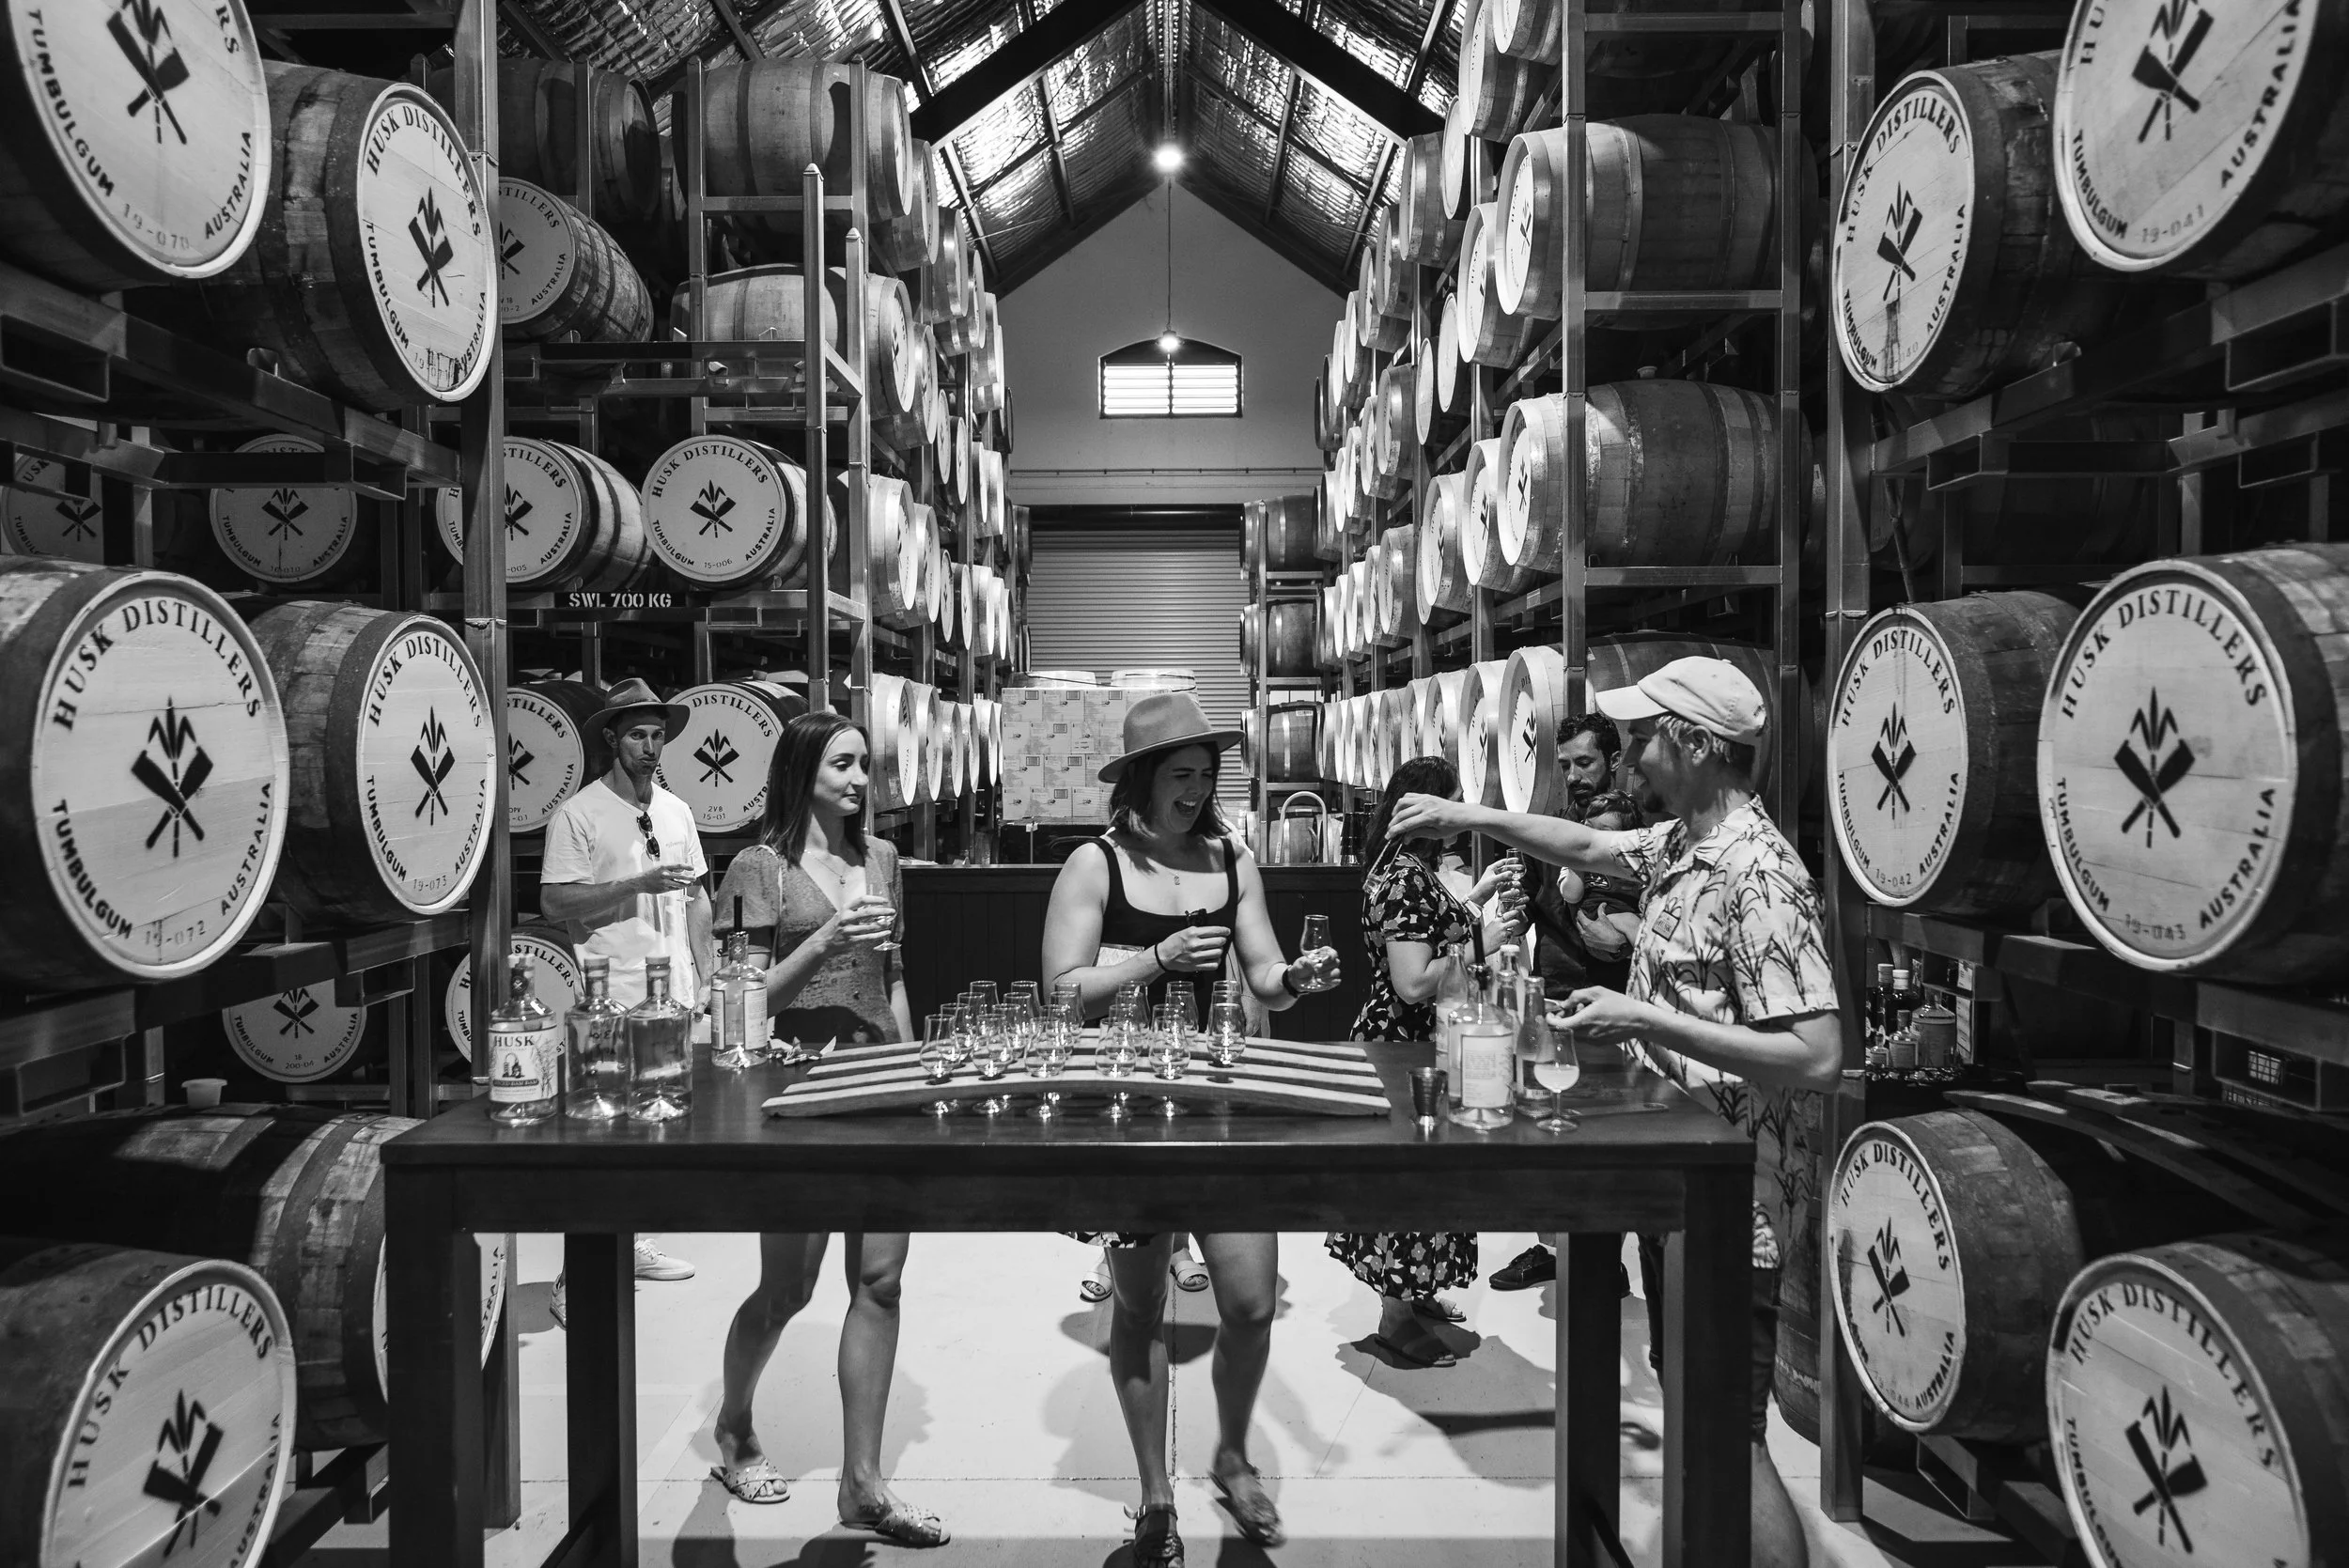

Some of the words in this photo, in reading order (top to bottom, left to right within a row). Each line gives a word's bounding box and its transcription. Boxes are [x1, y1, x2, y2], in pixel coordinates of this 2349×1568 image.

[2079, 6, 2106, 64] HU
[29, 8, 115, 197] TUMBULGUM
[2221, 0, 2300, 188] AUSTRALIA
[204, 131, 252, 240] AUSTRALIA
[366, 110, 400, 176] HUSK
[403, 105, 481, 237] DISTILLERS
[498, 186, 561, 229] STILLERS
[1845, 158, 1873, 242] HUSK
[1876, 97, 1960, 154] DISTILLERS
[2073, 129, 2128, 240] TUMBULGUM
[366, 222, 410, 349] TUMBULGUM
[531, 253, 567, 305] AUSTRALIA
[1927, 203, 1966, 333] AUSTRALIA
[455, 290, 487, 372] AUSTRALIA
[1843, 288, 1877, 370] TUMBULGUM
[23, 458, 50, 483] USK
[504, 447, 567, 489] STILLERS
[652, 458, 680, 498] HUSK
[683, 444, 769, 484] DISTILLERS
[222, 516, 261, 567] TUMBULGUM
[312, 516, 348, 567] AUSTRALIA
[506, 565, 527, 573] -005
[540, 512, 572, 565] AUSTRALIA
[652, 519, 695, 567] TUMBULGUM
[744, 507, 775, 562] AUSTRALIA
[568, 593, 606, 608] SWL
[611, 593, 645, 608] 700
[648, 593, 672, 608] KG
[53, 624, 115, 731] HUSK
[122, 598, 262, 718] DISTILLERS
[369, 653, 404, 728] HUSK
[406, 635, 483, 728] DISTILLERS
[1842, 657, 1870, 727] HUSK
[1873, 629, 1955, 715] DISTILLERS
[2061, 623, 2110, 720] HUSK
[2117, 589, 2268, 707] DISTILLERS
[507, 696, 568, 739] STILLERS
[692, 693, 773, 737] DISTILLERS
[366, 775, 407, 881] TUMBULGUM
[455, 777, 487, 875] AUSTRALIA
[541, 762, 575, 815] AUSTRALIA
[1838, 771, 1871, 869] TUMBULGUM
[1920, 772, 1959, 877] AUSTRALIA
[51, 799, 132, 939] TUMBULGUM
[219, 782, 272, 917] AUSTRALIA
[2056, 778, 2110, 913] TUMBULGUM
[2199, 787, 2278, 929] AUSTRALIA
[513, 943, 574, 988] STILLERS
[234, 1015, 274, 1064] TUMBULGUM
[323, 1013, 358, 1063] AUSTRALIA
[493, 1035, 535, 1048] HUSK
[1841, 1150, 1869, 1207] HUSK
[1873, 1143, 1950, 1271] DISTILLERS
[68, 1359, 131, 1489] HUSK
[137, 1285, 273, 1359] DISTILLERS
[1915, 1330, 1955, 1409] AUSTRALIA
[2069, 1291, 2116, 1366] HUSK
[2122, 1281, 2275, 1468] DISTILLERS
